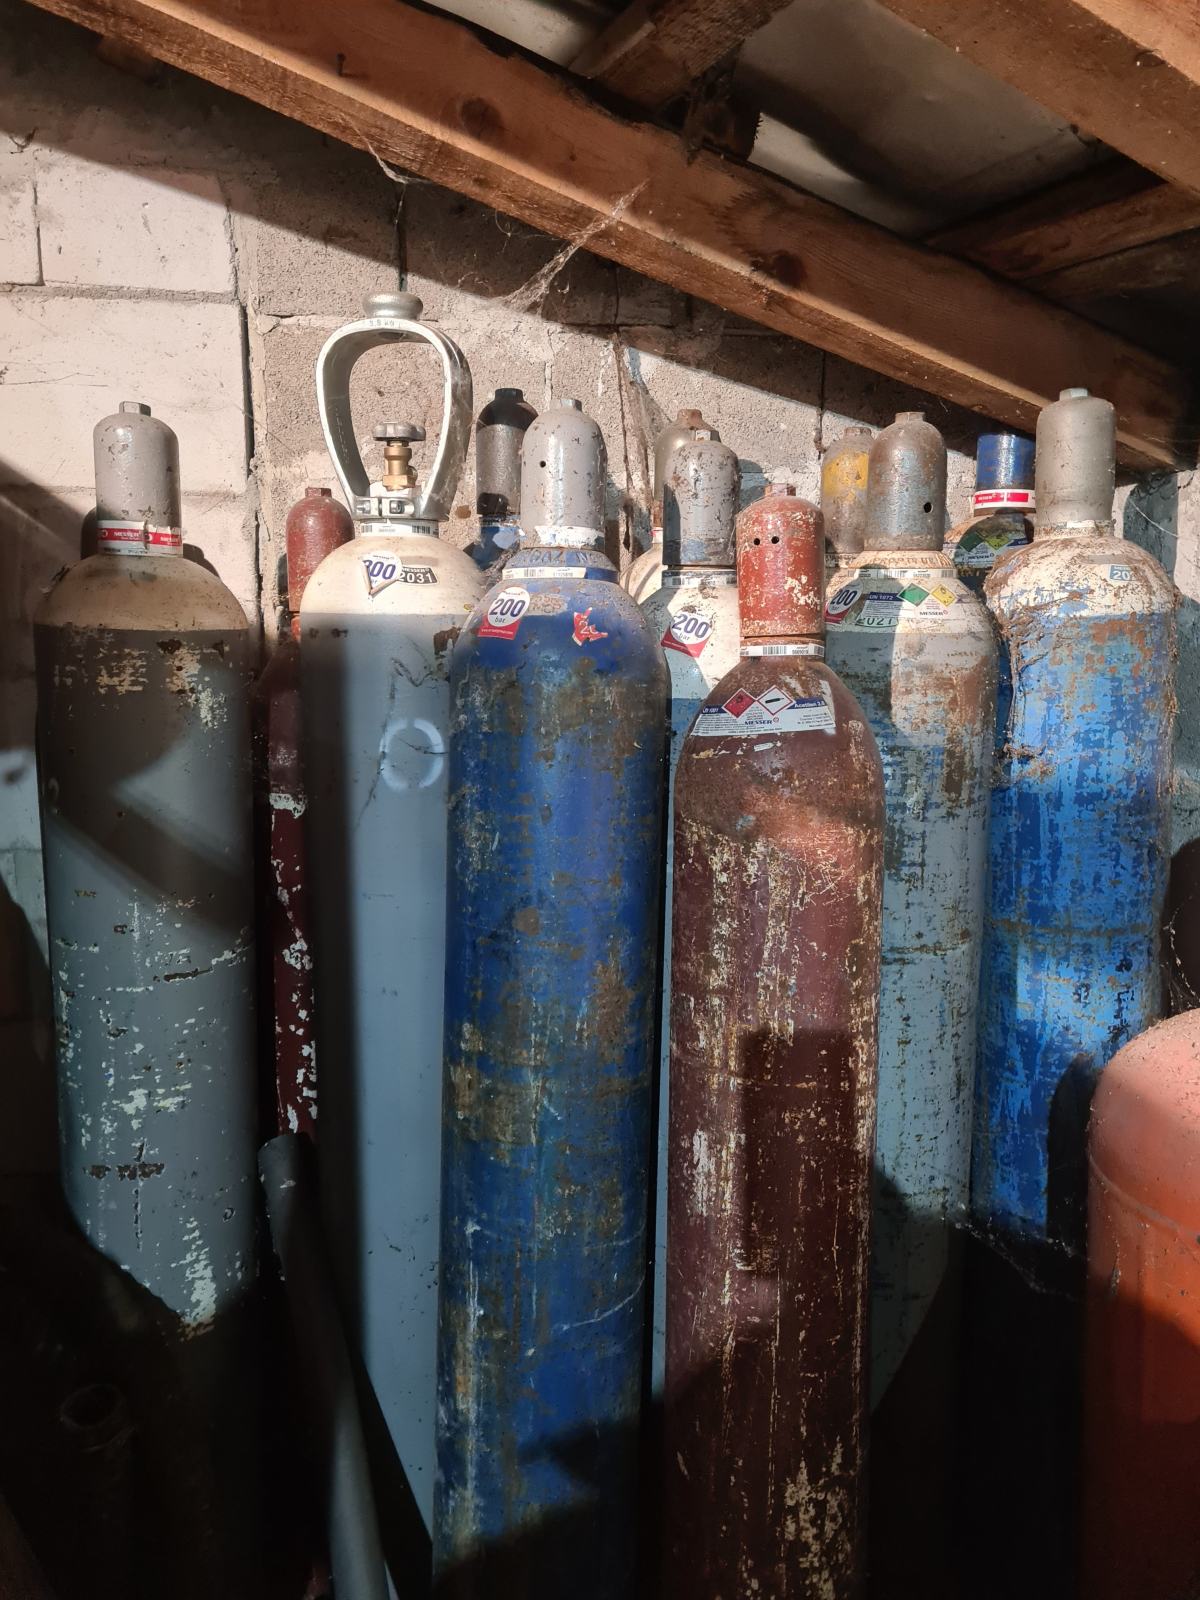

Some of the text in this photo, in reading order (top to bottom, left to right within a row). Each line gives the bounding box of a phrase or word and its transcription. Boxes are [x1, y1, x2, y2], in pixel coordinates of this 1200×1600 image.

[400, 572, 434, 583] 2031
[830, 589, 858, 606] 200
[489, 598, 526, 617] 200
[672, 613, 710, 639] 200
